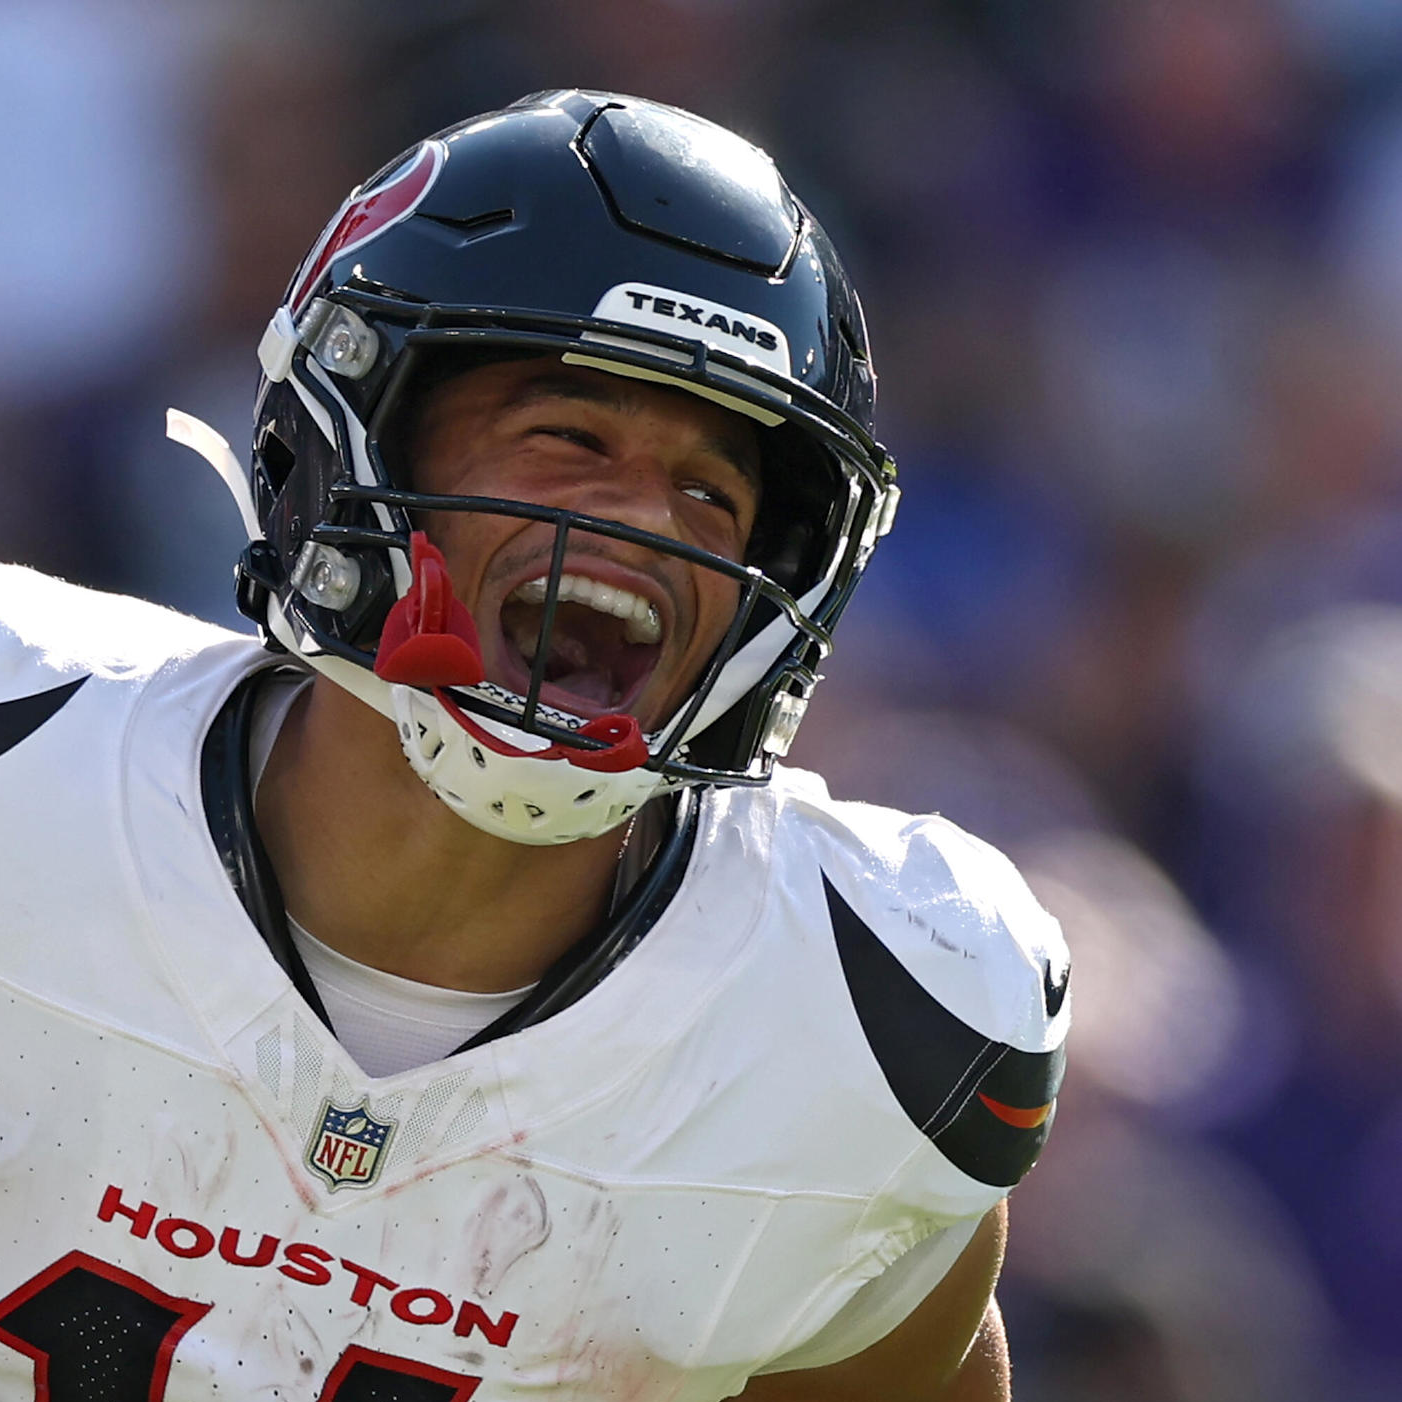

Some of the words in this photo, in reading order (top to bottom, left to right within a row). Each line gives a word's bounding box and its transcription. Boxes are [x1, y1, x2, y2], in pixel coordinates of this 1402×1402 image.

[625, 291, 778, 351] TEXANS
[316, 1134, 369, 1177] NFL
[97, 1184, 520, 1347] HOUSTON
